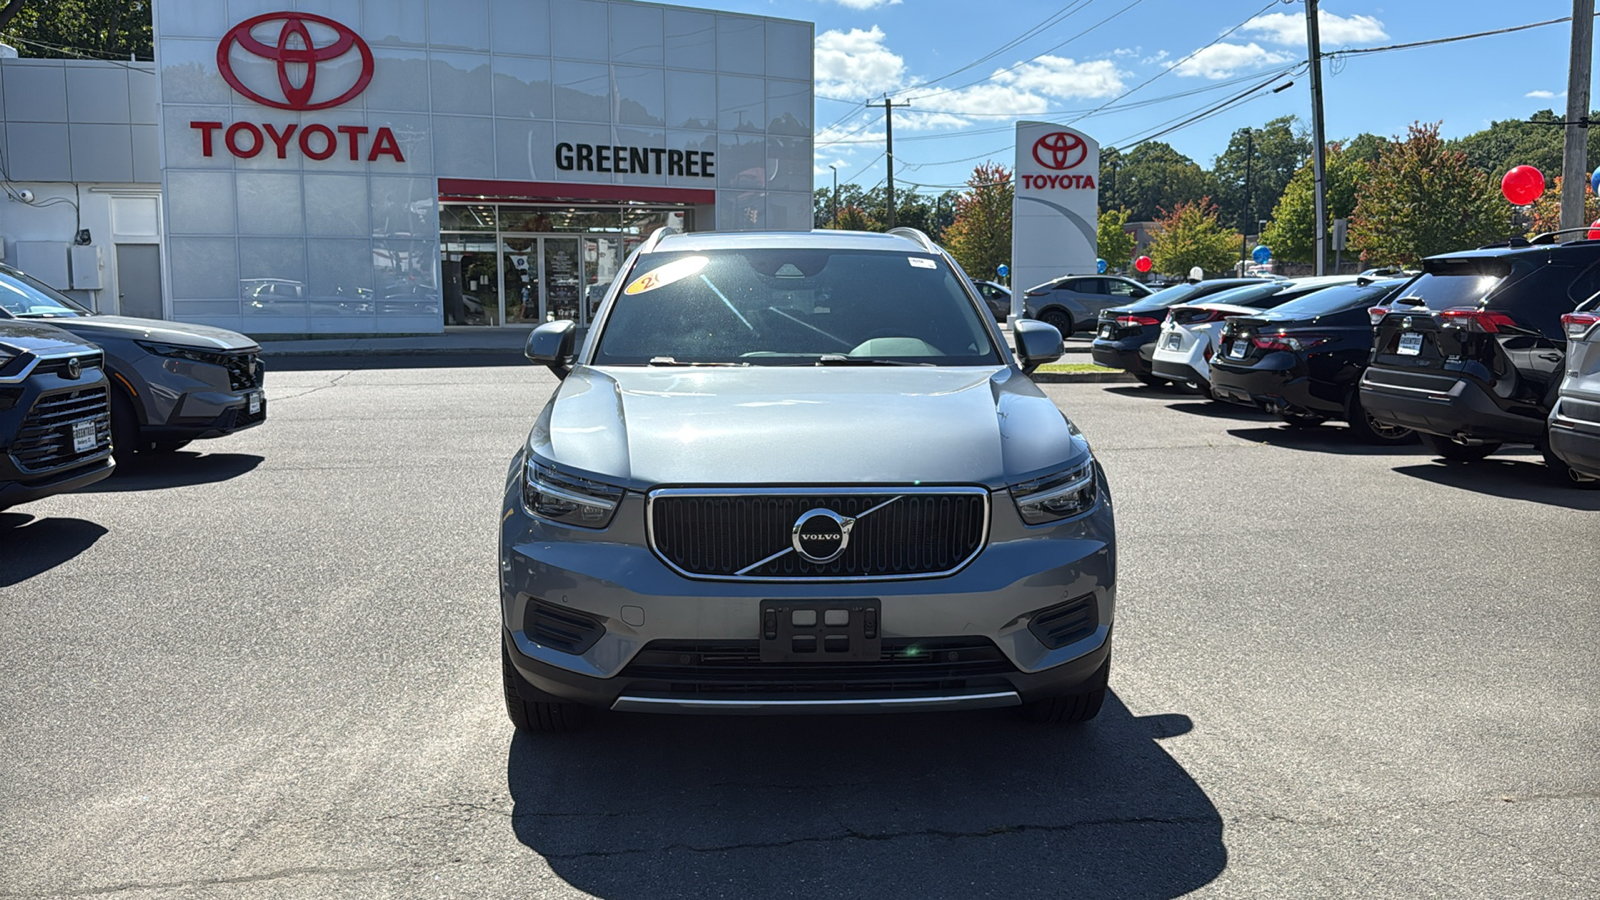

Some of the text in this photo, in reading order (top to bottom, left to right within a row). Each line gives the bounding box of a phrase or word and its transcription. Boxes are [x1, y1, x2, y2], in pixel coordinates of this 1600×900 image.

[190, 121, 405, 162] TOYOTA
[555, 142, 715, 178] GREENTREE
[1021, 174, 1096, 190] TOYOTA
